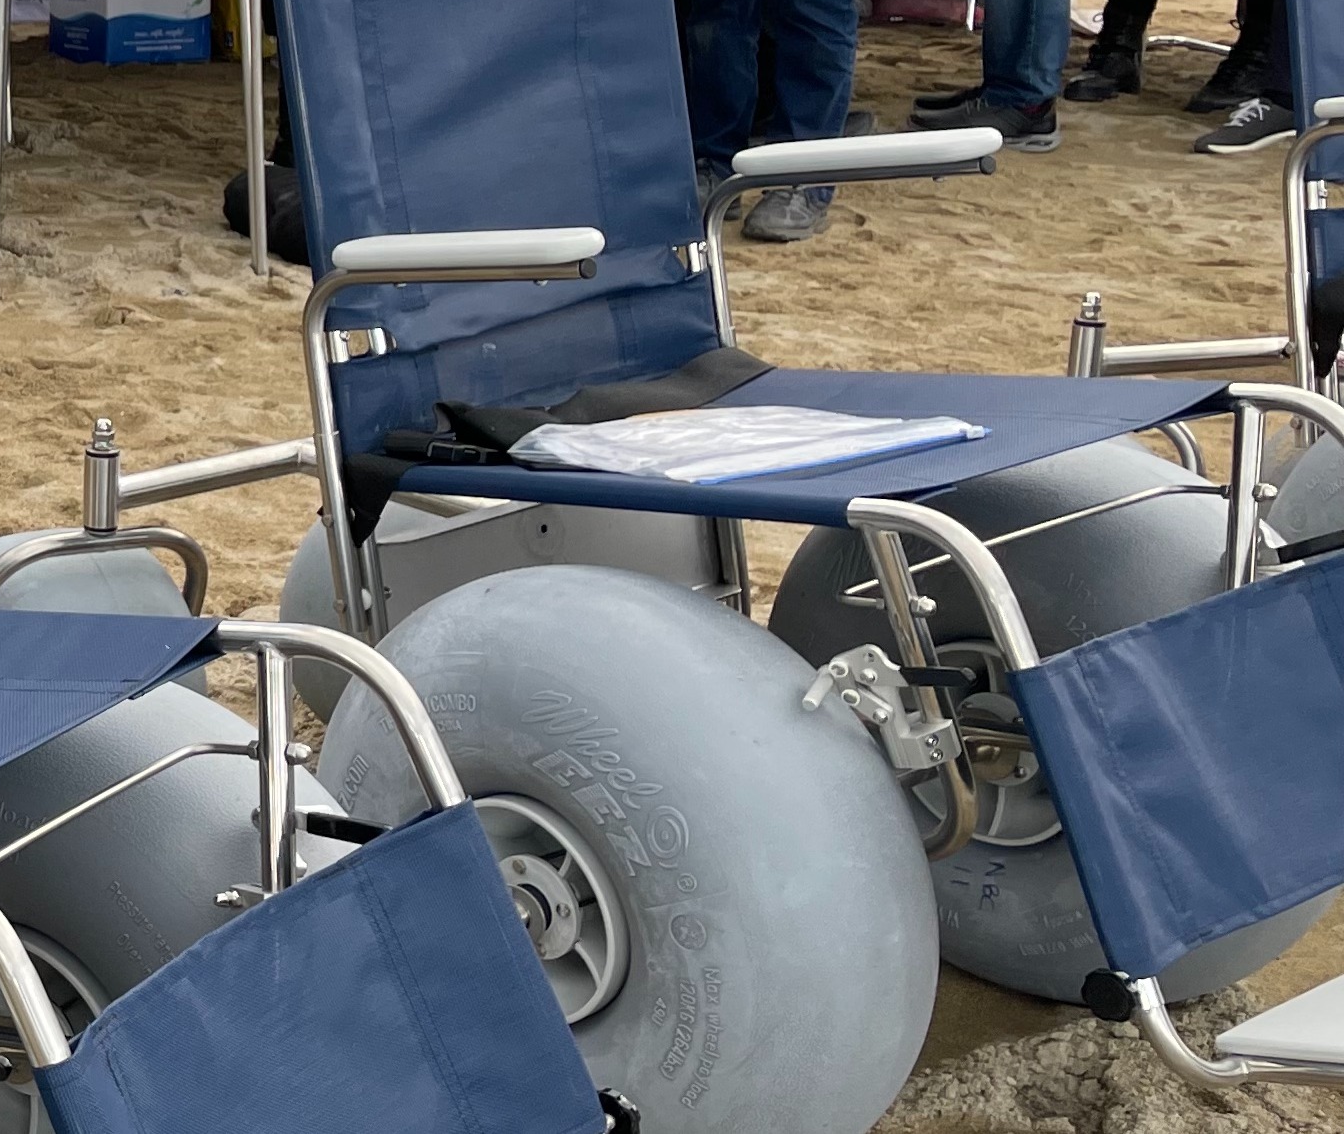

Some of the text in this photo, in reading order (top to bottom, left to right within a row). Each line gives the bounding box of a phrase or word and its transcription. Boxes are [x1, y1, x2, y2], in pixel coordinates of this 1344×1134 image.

[520, 689, 664, 810] Wheel
[531, 748, 652, 877] EEZ
[680, 967, 725, 1110] Max wheel payload
